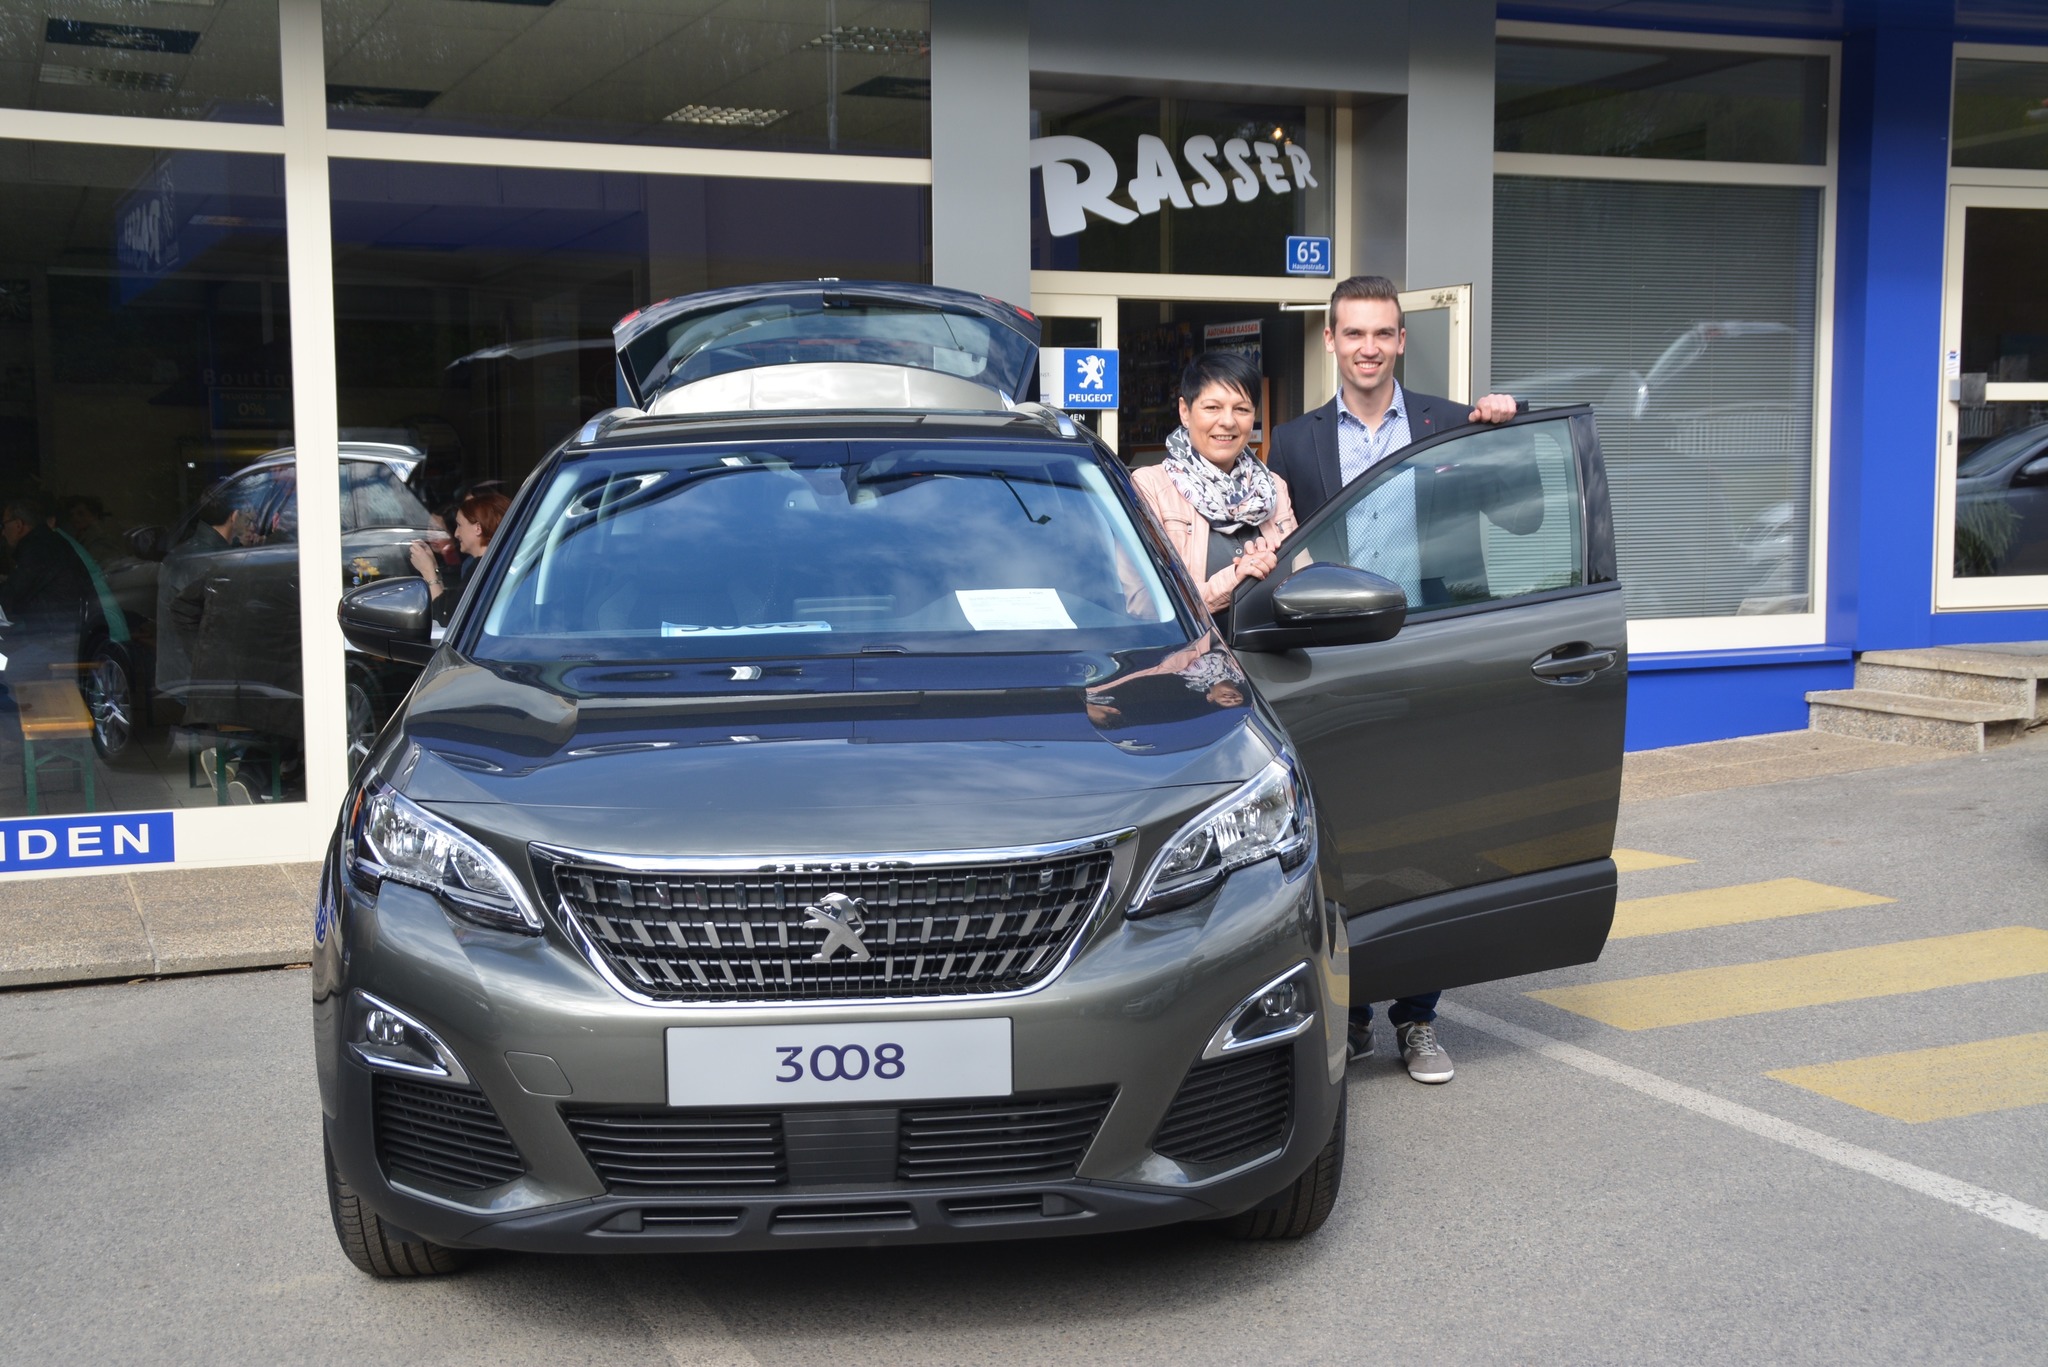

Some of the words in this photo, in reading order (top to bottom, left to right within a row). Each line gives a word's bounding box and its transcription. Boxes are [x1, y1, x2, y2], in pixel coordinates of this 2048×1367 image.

[1030, 133, 1318, 237] RASSER
[1297, 241, 1320, 263] 65
[1292, 263, 1325, 271] Hauptstraße
[1069, 393, 1113, 403] PEUGEOT
[238, 402, 266, 416] 0%
[775, 861, 898, 873] PEUGEOT
[776, 1042, 905, 1083] 3008
